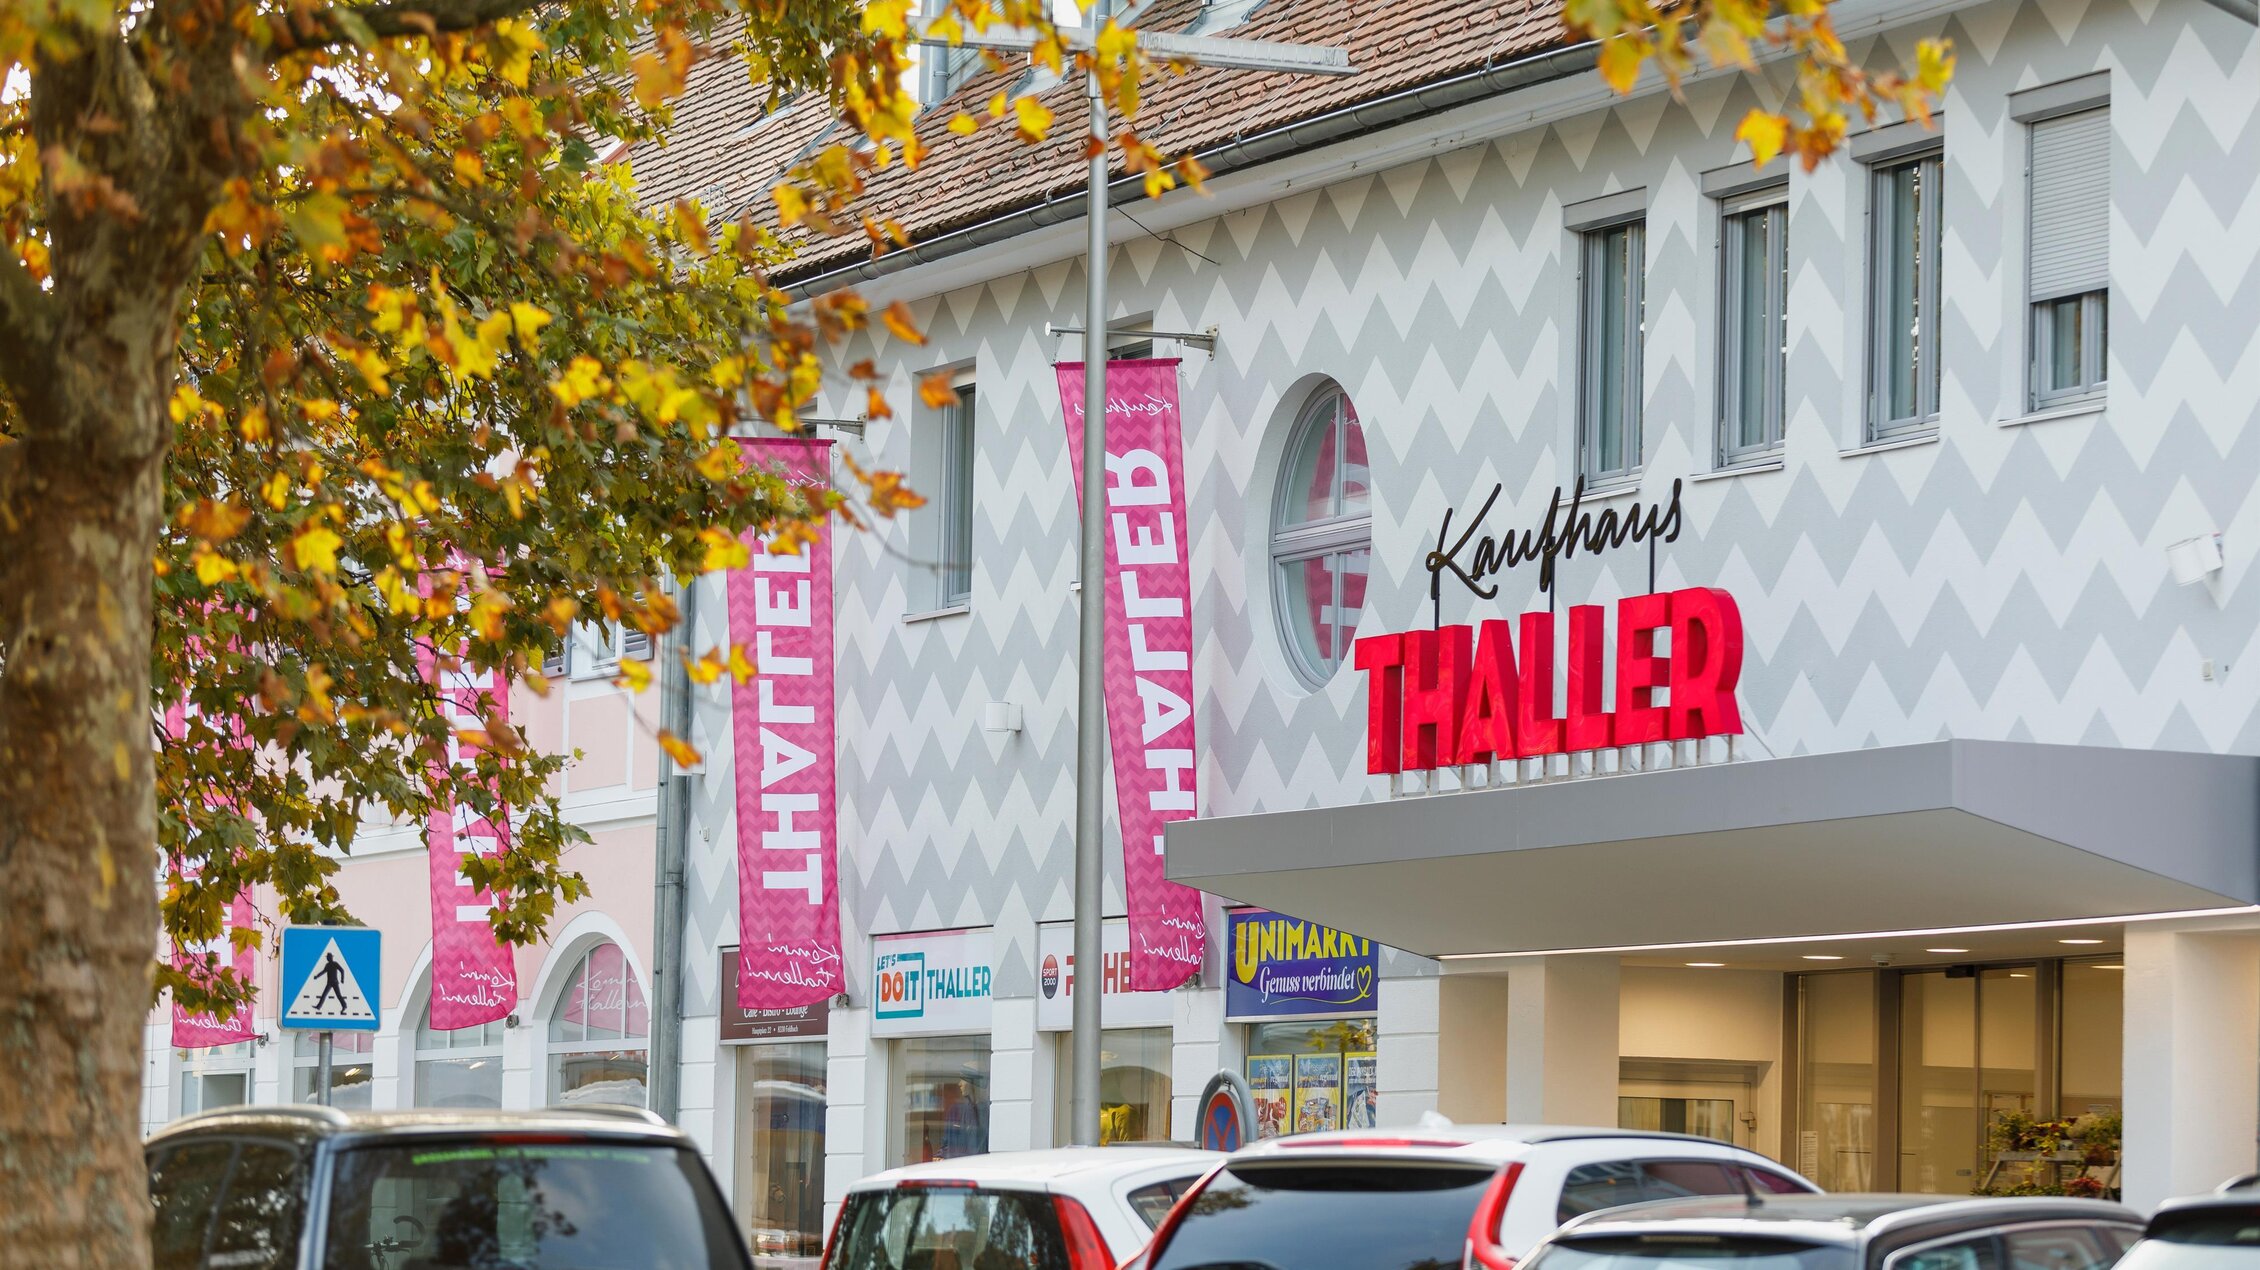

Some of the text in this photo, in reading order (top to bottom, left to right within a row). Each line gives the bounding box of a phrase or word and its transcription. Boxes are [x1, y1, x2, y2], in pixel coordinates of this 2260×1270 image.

[1426, 473, 1682, 600] Kaufhaus
[1355, 586, 1744, 775] THALLER
[926, 966, 992, 999] THALLER
[1042, 967, 1058, 977] SPORT
[1043, 977, 1057, 986] 2000
[1259, 966, 1355, 1003] Genuss verbindet
